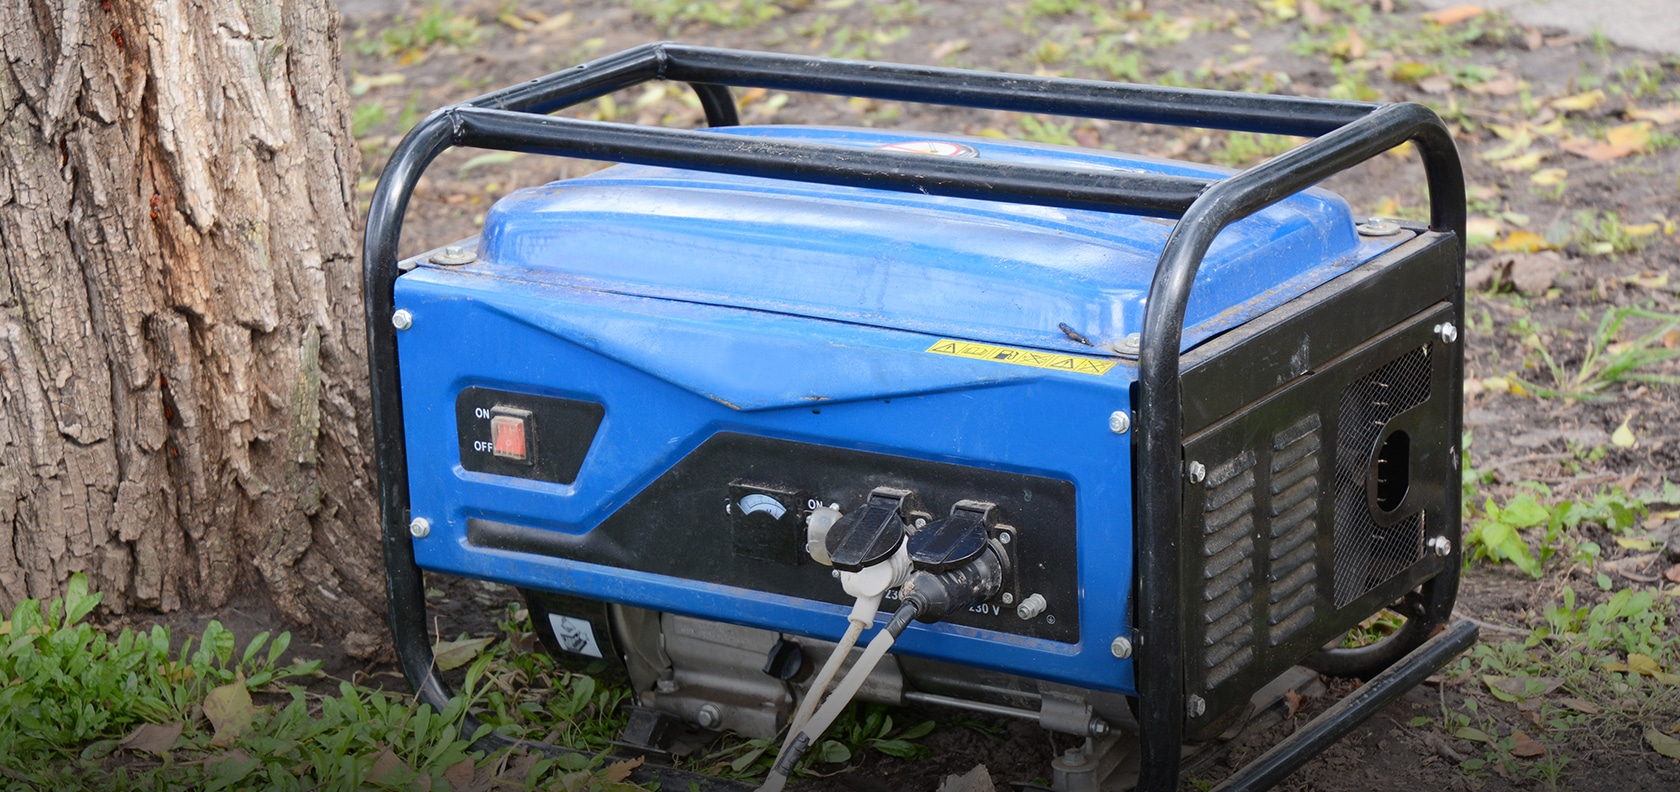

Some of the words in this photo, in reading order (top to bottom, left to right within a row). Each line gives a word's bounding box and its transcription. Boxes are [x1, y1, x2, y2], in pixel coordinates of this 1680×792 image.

[475, 407, 490, 419] ON
[474, 440, 493, 453] OFF
[807, 498, 823, 509] ON
[884, 589, 901, 600] 23
[992, 604, 1000, 616] V
